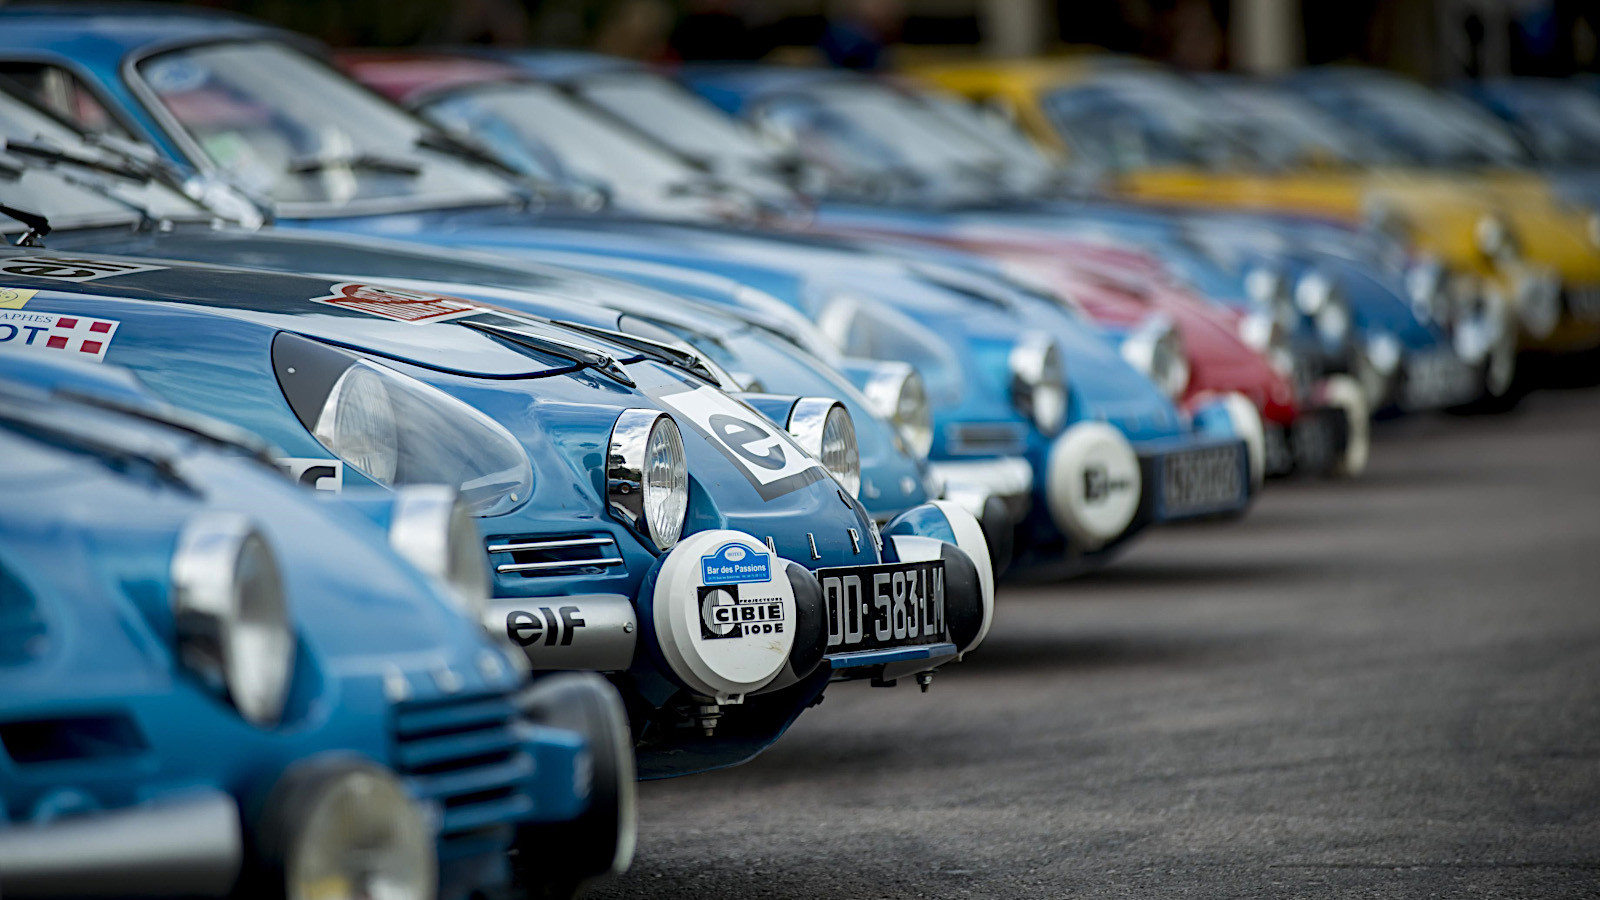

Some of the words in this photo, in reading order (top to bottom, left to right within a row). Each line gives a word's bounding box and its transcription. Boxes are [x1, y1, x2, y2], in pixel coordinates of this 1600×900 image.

[707, 566, 719, 575] Bar
[721, 565, 734, 574] des
[734, 563, 767, 573] Passions
[715, 605, 781, 622] CIBIE
[506, 606, 586, 646] elf
[744, 623, 784, 635] IODE
